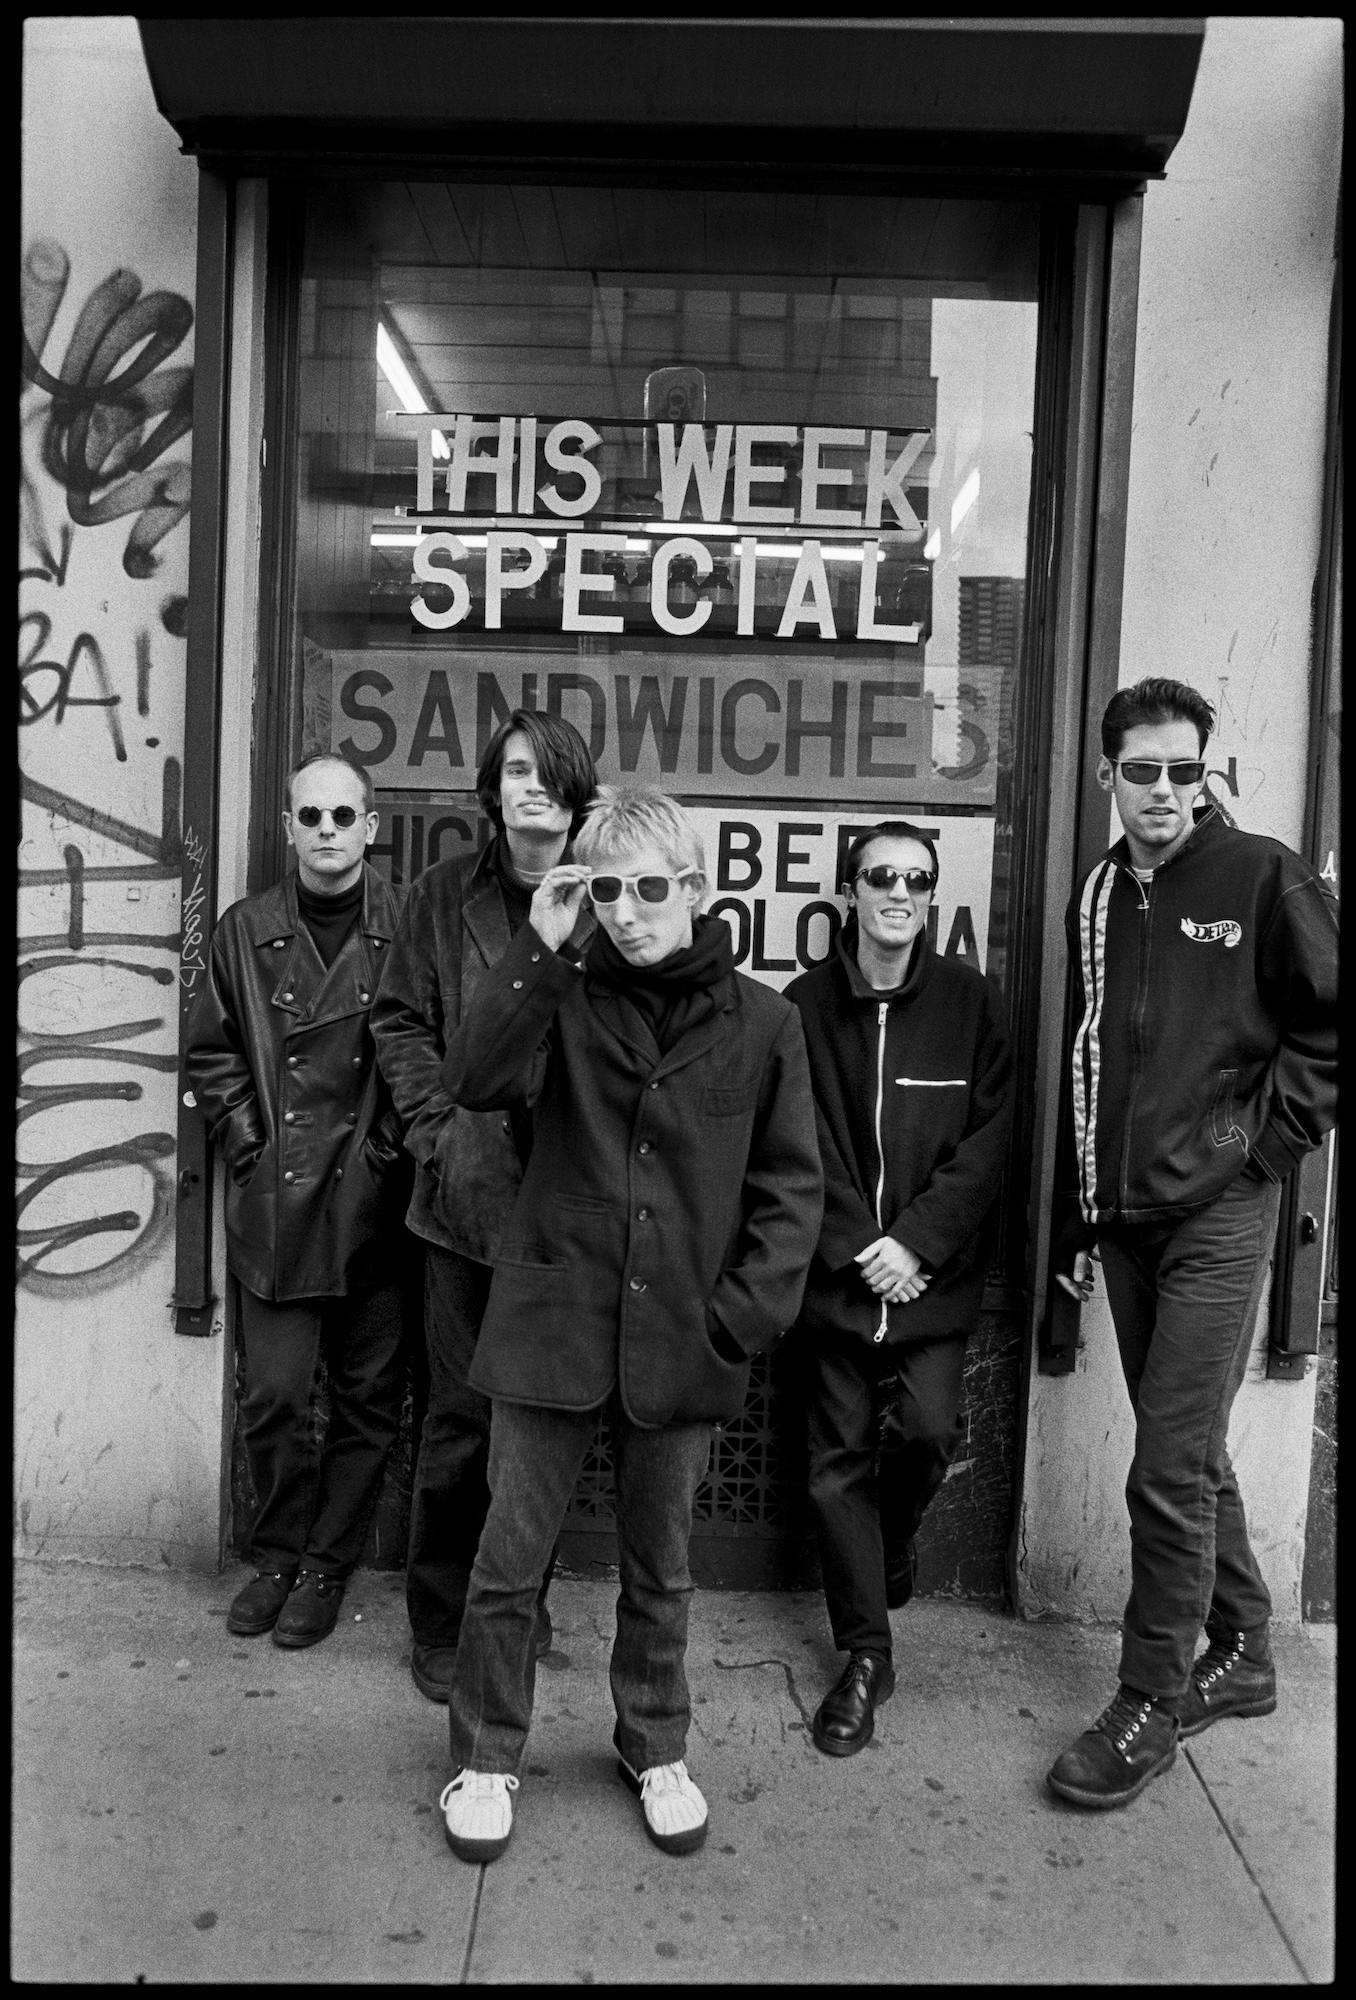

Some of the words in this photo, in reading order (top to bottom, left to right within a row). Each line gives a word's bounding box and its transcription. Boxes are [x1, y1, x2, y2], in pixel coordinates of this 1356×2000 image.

[404, 414, 604, 518] THIS
[656, 422, 932, 531] WEEK
[410, 531, 920, 643] SPECIAL
[338, 669, 990, 781] SANDWICHES
